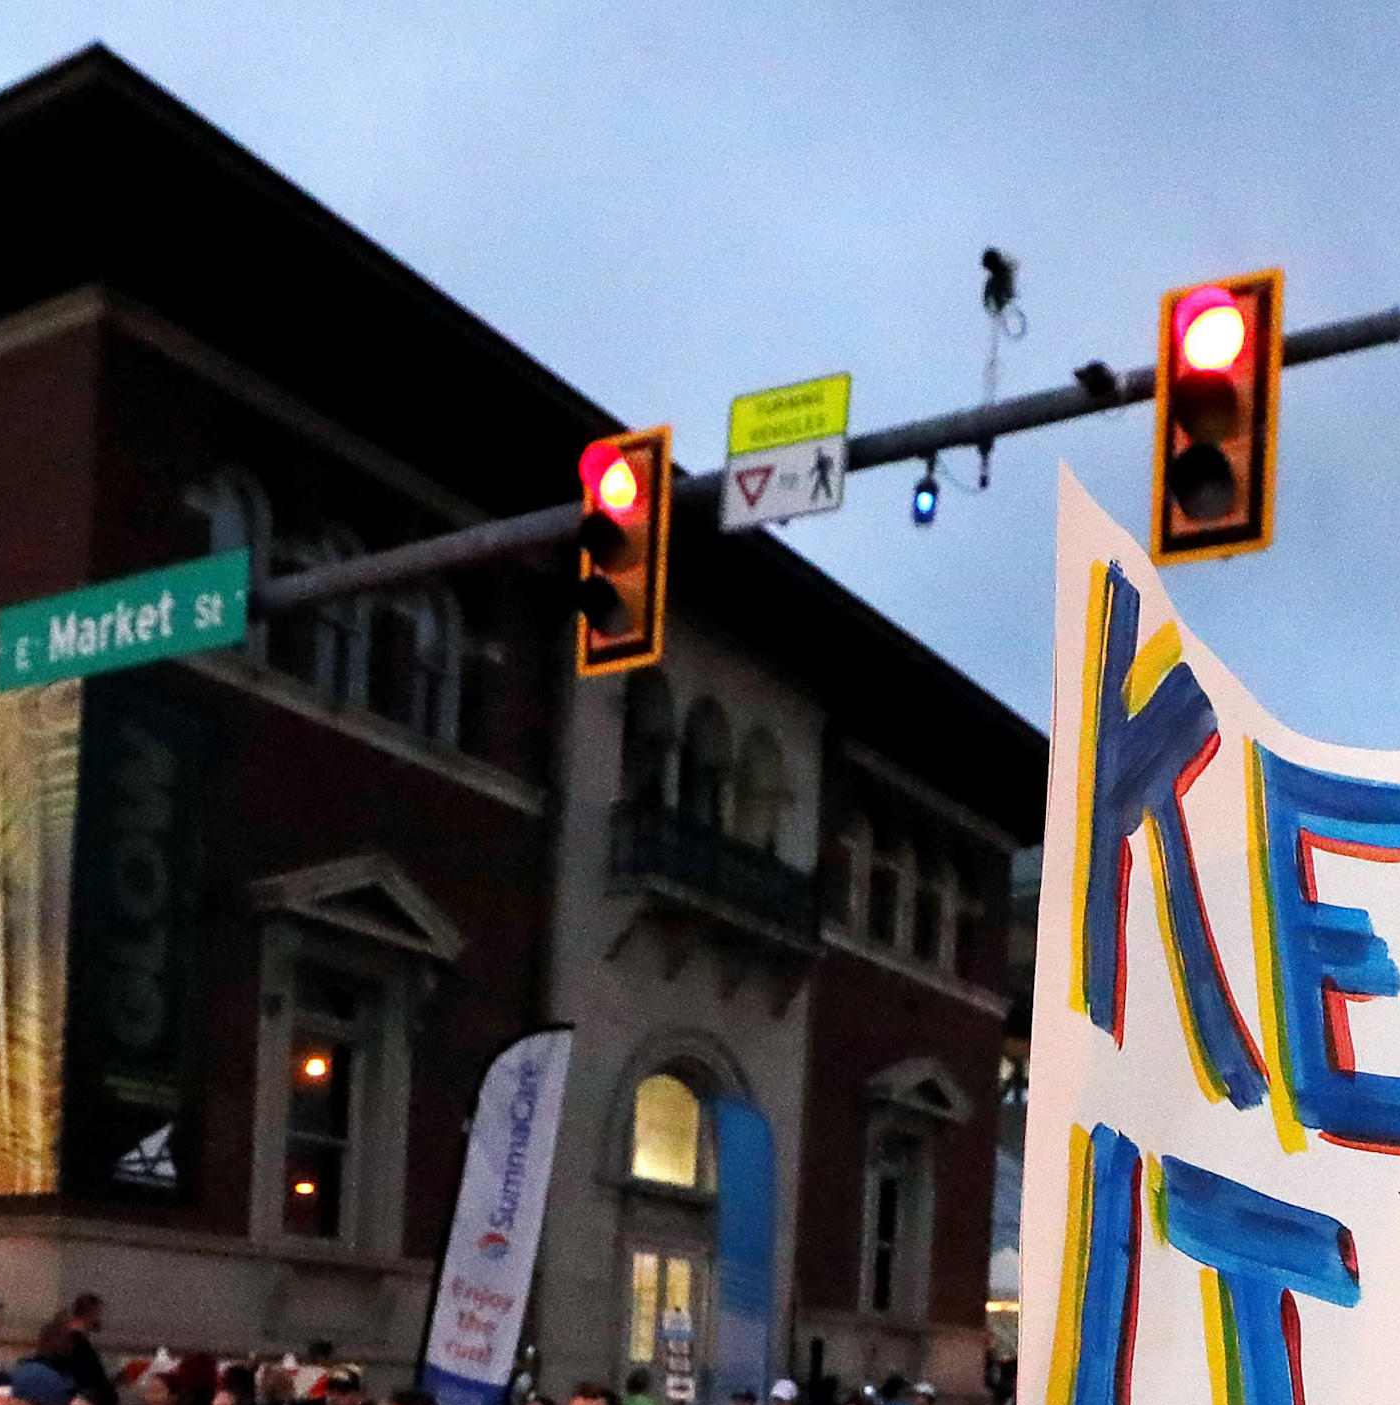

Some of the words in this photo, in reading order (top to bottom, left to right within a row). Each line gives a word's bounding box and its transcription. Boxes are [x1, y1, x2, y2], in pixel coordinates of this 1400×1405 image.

[14, 636, 32, 673] E
[49, 588, 176, 663] Market
[489, 1061, 538, 1230] SummaCare
